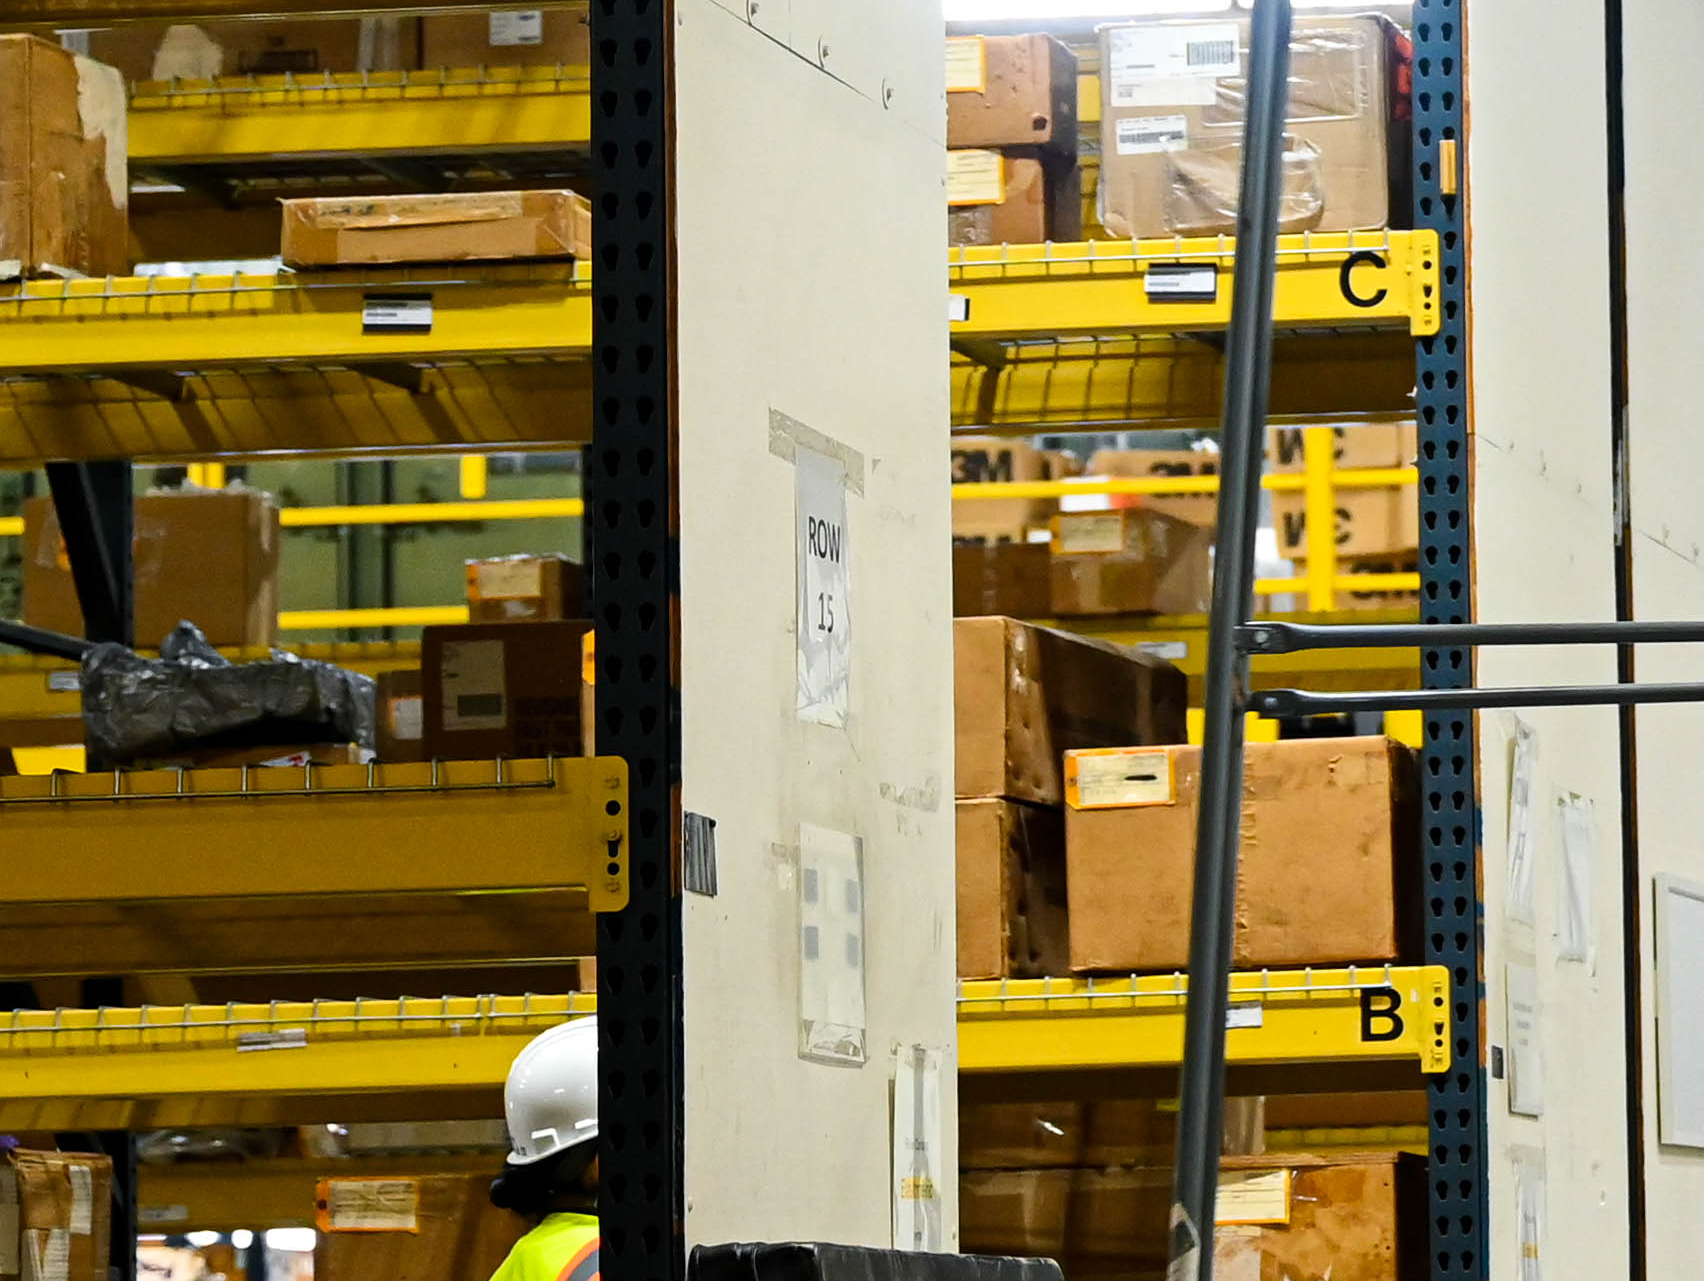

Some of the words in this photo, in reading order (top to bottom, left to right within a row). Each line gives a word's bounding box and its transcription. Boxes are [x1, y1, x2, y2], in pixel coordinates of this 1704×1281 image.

[1339, 250, 1388, 308] C
[808, 516, 841, 563] ROW
[817, 592, 834, 633] 15
[1360, 988, 1404, 1043] B
